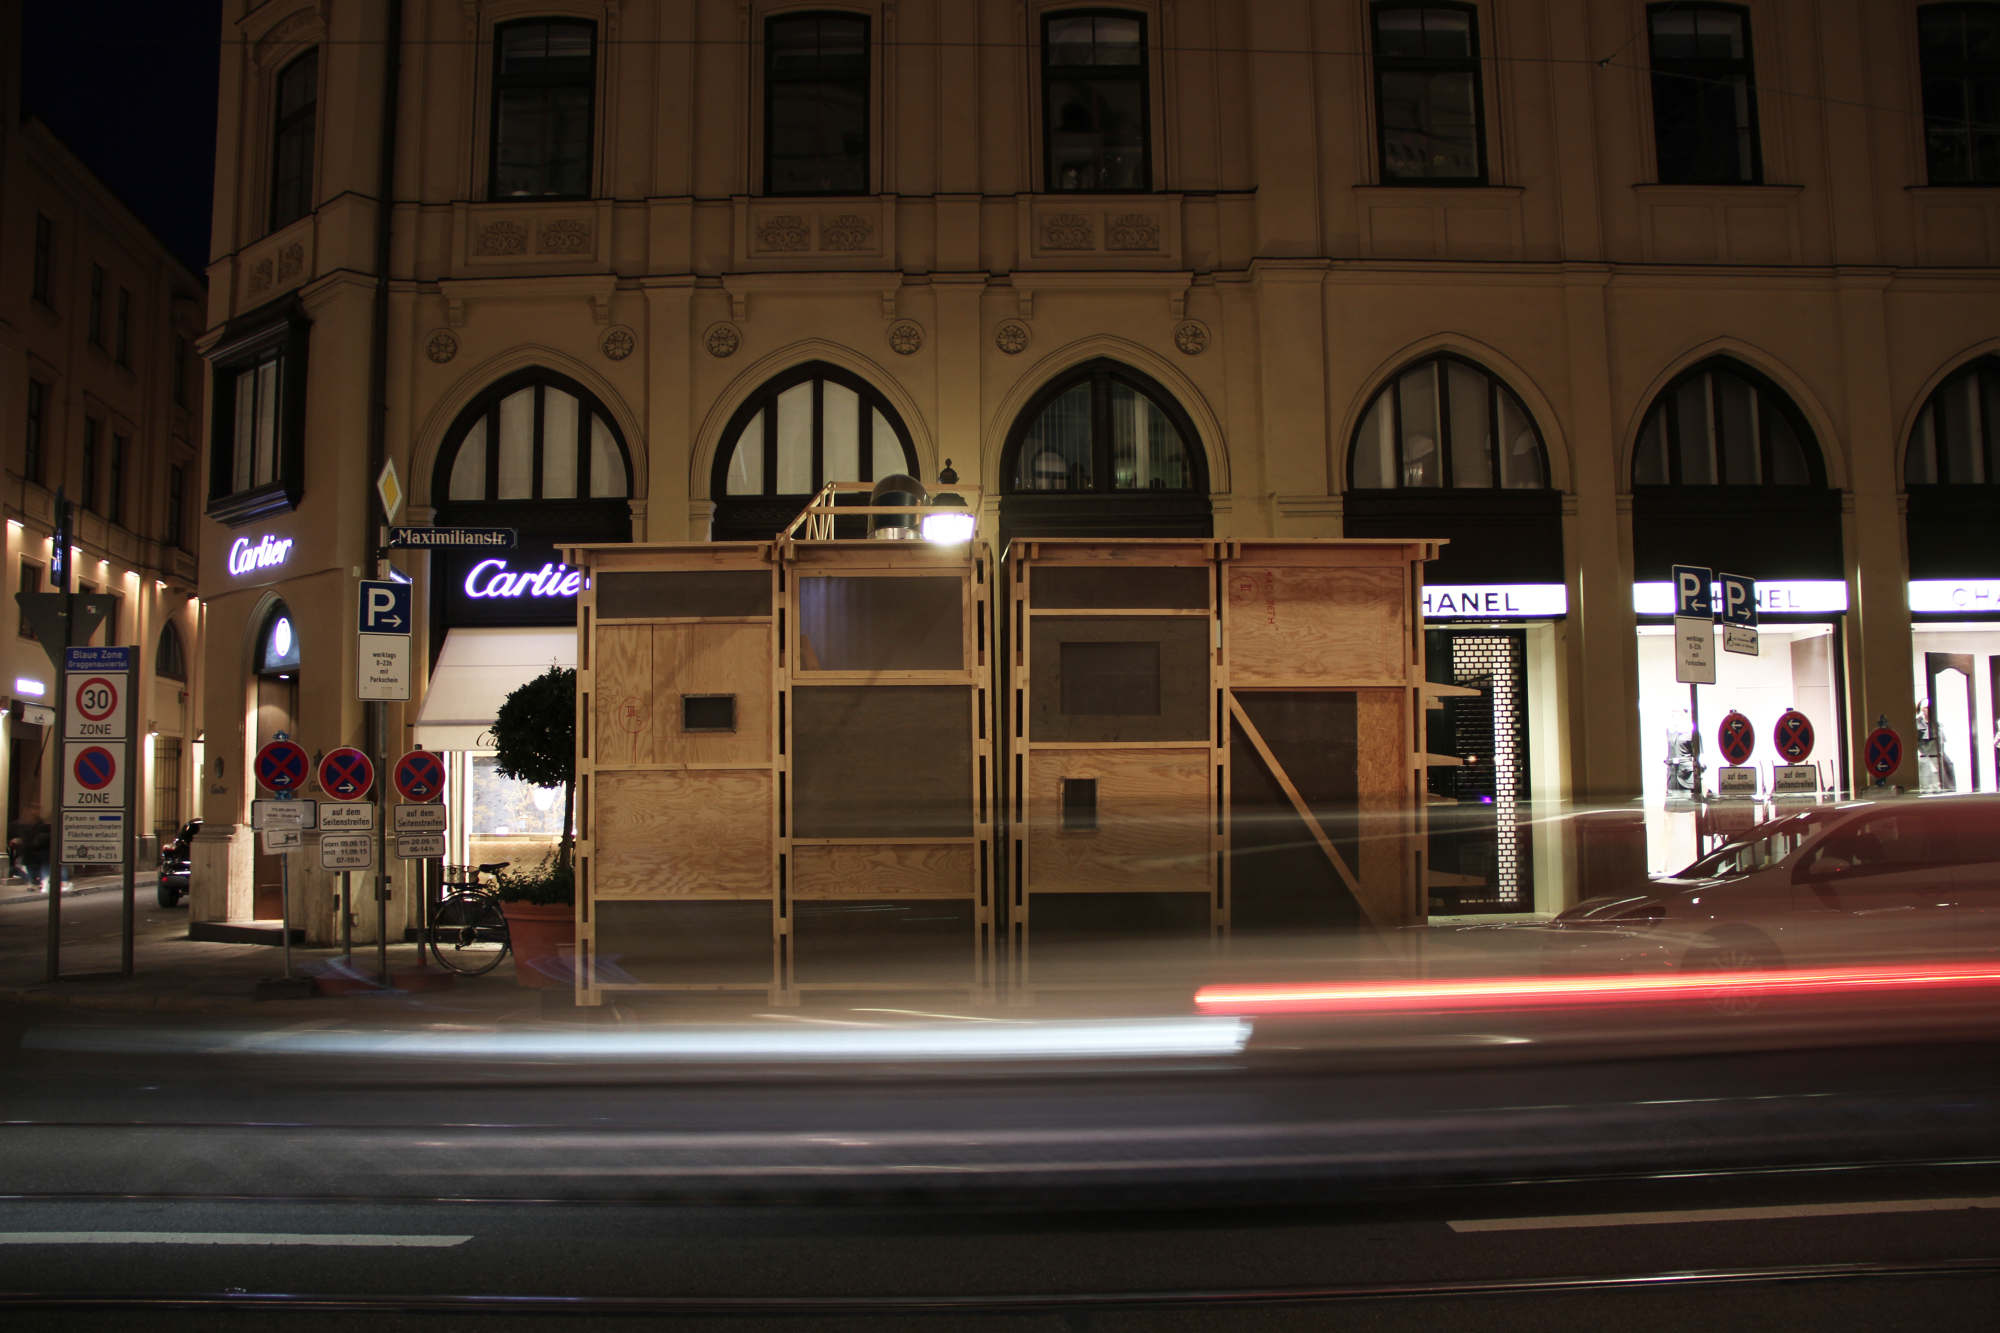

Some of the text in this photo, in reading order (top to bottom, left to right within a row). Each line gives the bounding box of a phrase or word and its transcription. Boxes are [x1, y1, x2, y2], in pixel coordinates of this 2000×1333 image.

[398, 529, 506, 545] Maximilianstr.
[229, 535, 293, 576] Cartier
[464, 559, 590, 598] Cartie
[1680, 572, 1701, 611] P
[1725, 581, 1746, 617] P
[367, 588, 396, 627] P
[1423, 592, 1519, 612] HANEL
[72, 650, 123, 659] Blaue Zone
[84, 689, 109, 709] 30
[80, 723, 112, 735] ZONE
[78, 792, 110, 804] ZONE
[323, 818, 370, 826] Seitenstreifen
[332, 808, 361, 816] auf dem
